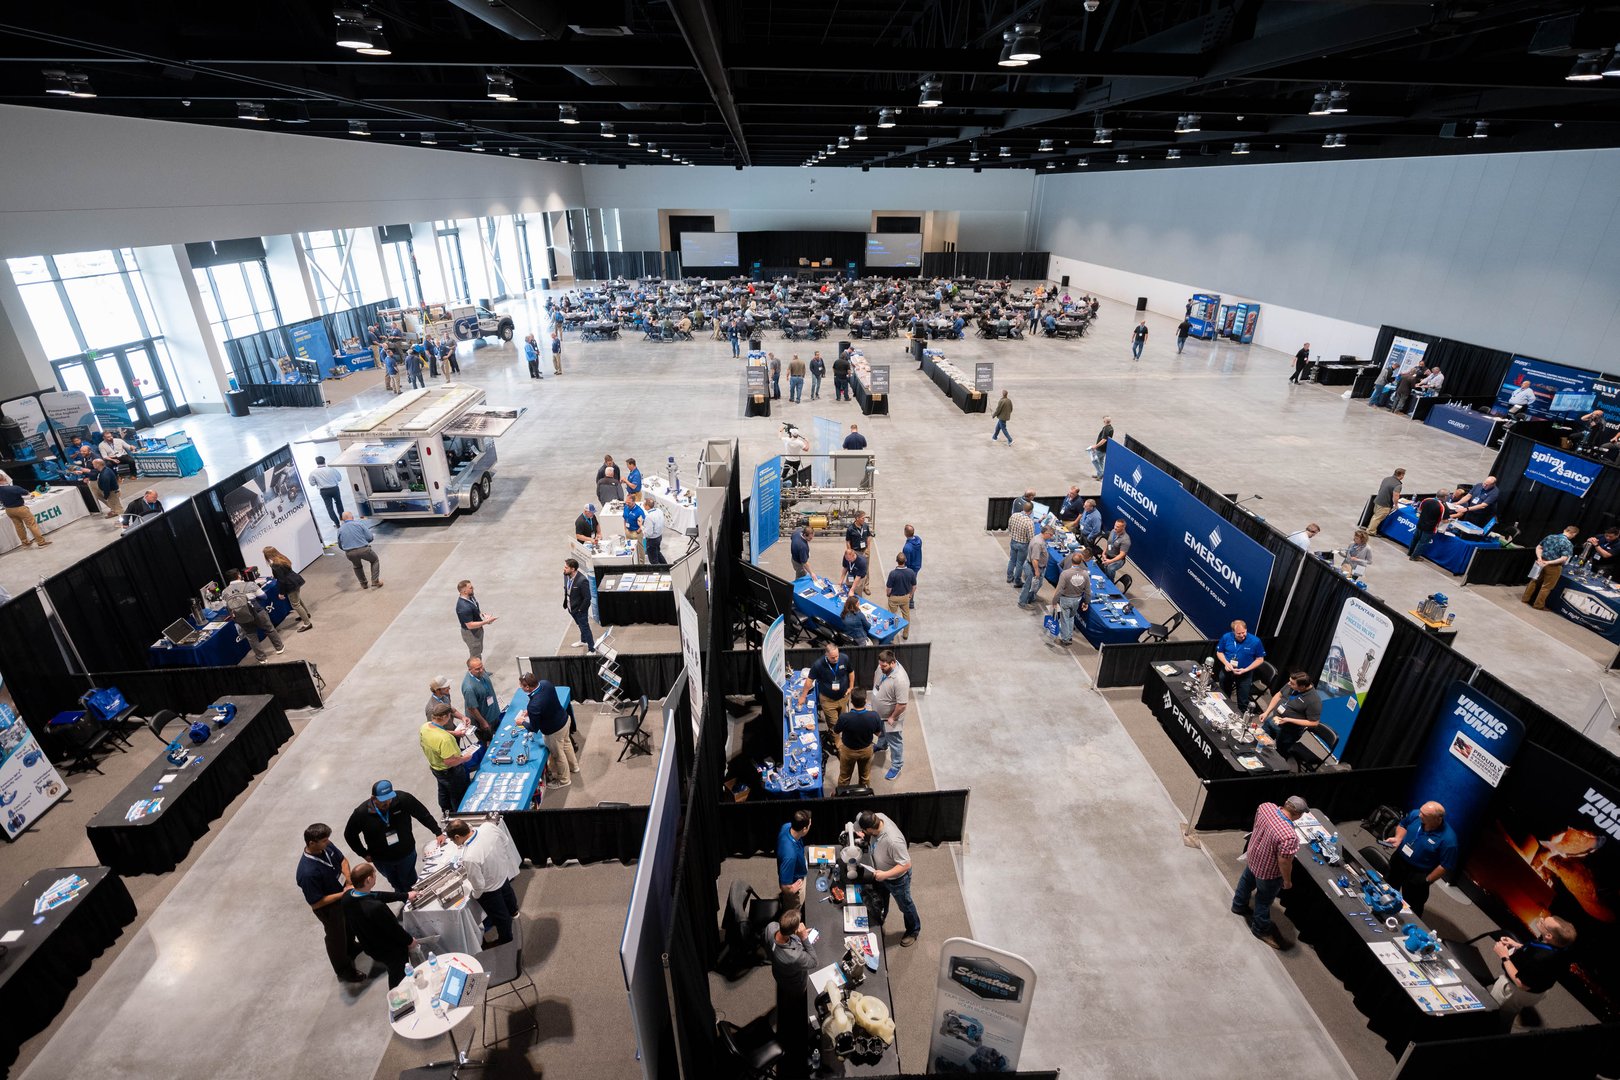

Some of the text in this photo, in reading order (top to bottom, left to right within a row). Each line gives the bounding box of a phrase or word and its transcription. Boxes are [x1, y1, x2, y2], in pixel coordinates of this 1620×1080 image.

[1531, 451, 1567, 472] spirax
[1556, 467, 1591, 484] sarco
[1113, 473, 1158, 517] EMERSON
[35, 505, 62, 524] ZSCH
[274, 502, 304, 526] SOLUTIONS
[1184, 531, 1241, 590] EMERSON
[1187, 568, 1205, 589] CONSIDER
[1210, 589, 1226, 608] SOLVED
[1355, 603, 1375, 618] PENTAIR
[1562, 592, 1614, 620] DIXON
[1454, 706, 1500, 740] PUMP
[1456, 694, 1508, 736] VIKING
[1172, 704, 1212, 759] PENTAIR
[1473, 749, 1502, 774] PROUDLY
[1584, 787, 1620, 826] VIK
[954, 966, 1017, 992] Signature
[961, 976, 1008, 996] SERIES
